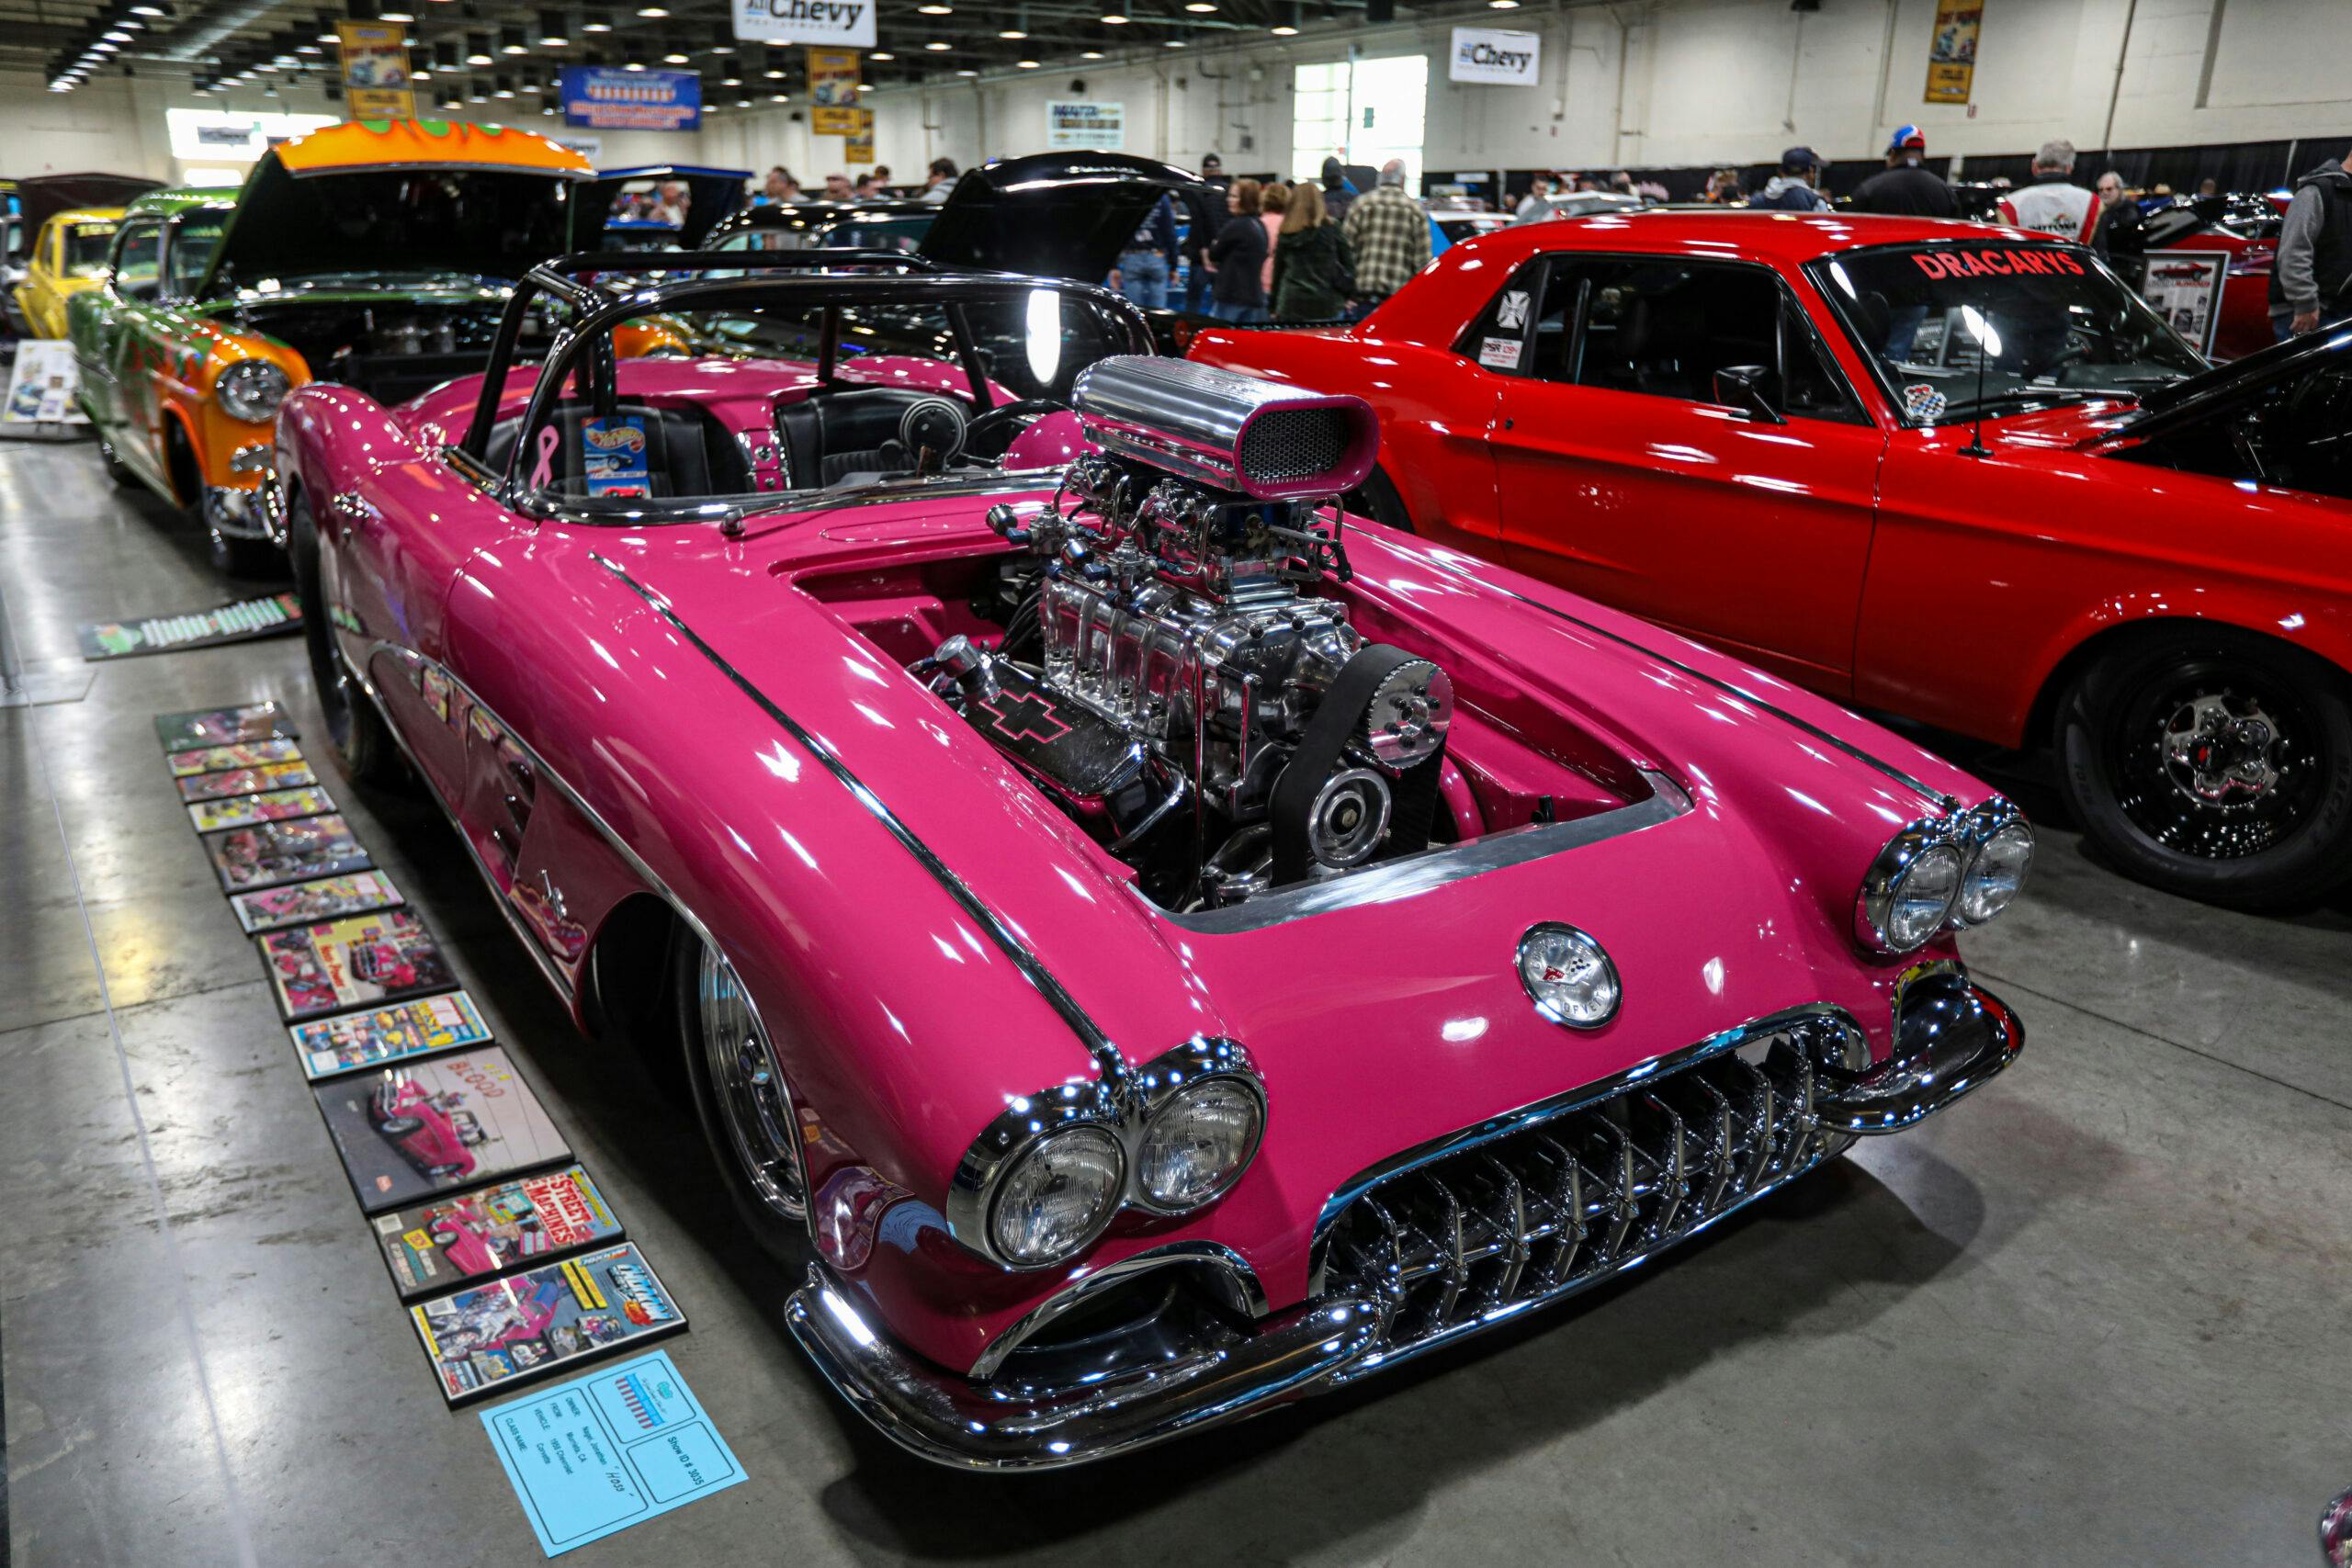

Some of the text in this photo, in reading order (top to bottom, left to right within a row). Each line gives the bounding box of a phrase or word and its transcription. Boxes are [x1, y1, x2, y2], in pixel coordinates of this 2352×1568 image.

[769, 0, 864, 31] Chevy
[1473, 42, 1532, 73] Chevy
[1911, 248, 2086, 280] DRACARYS
[1559, 984, 1609, 1015] ORVETTE
[526, 1183, 576, 1247] MACHINES
[549, 1178, 595, 1225] STREET
[576, 1453, 587, 1463] CA
[666, 1435, 685, 1455] Show
[678, 1453, 691, 1463] ID
[687, 1467, 705, 1485] 3035
